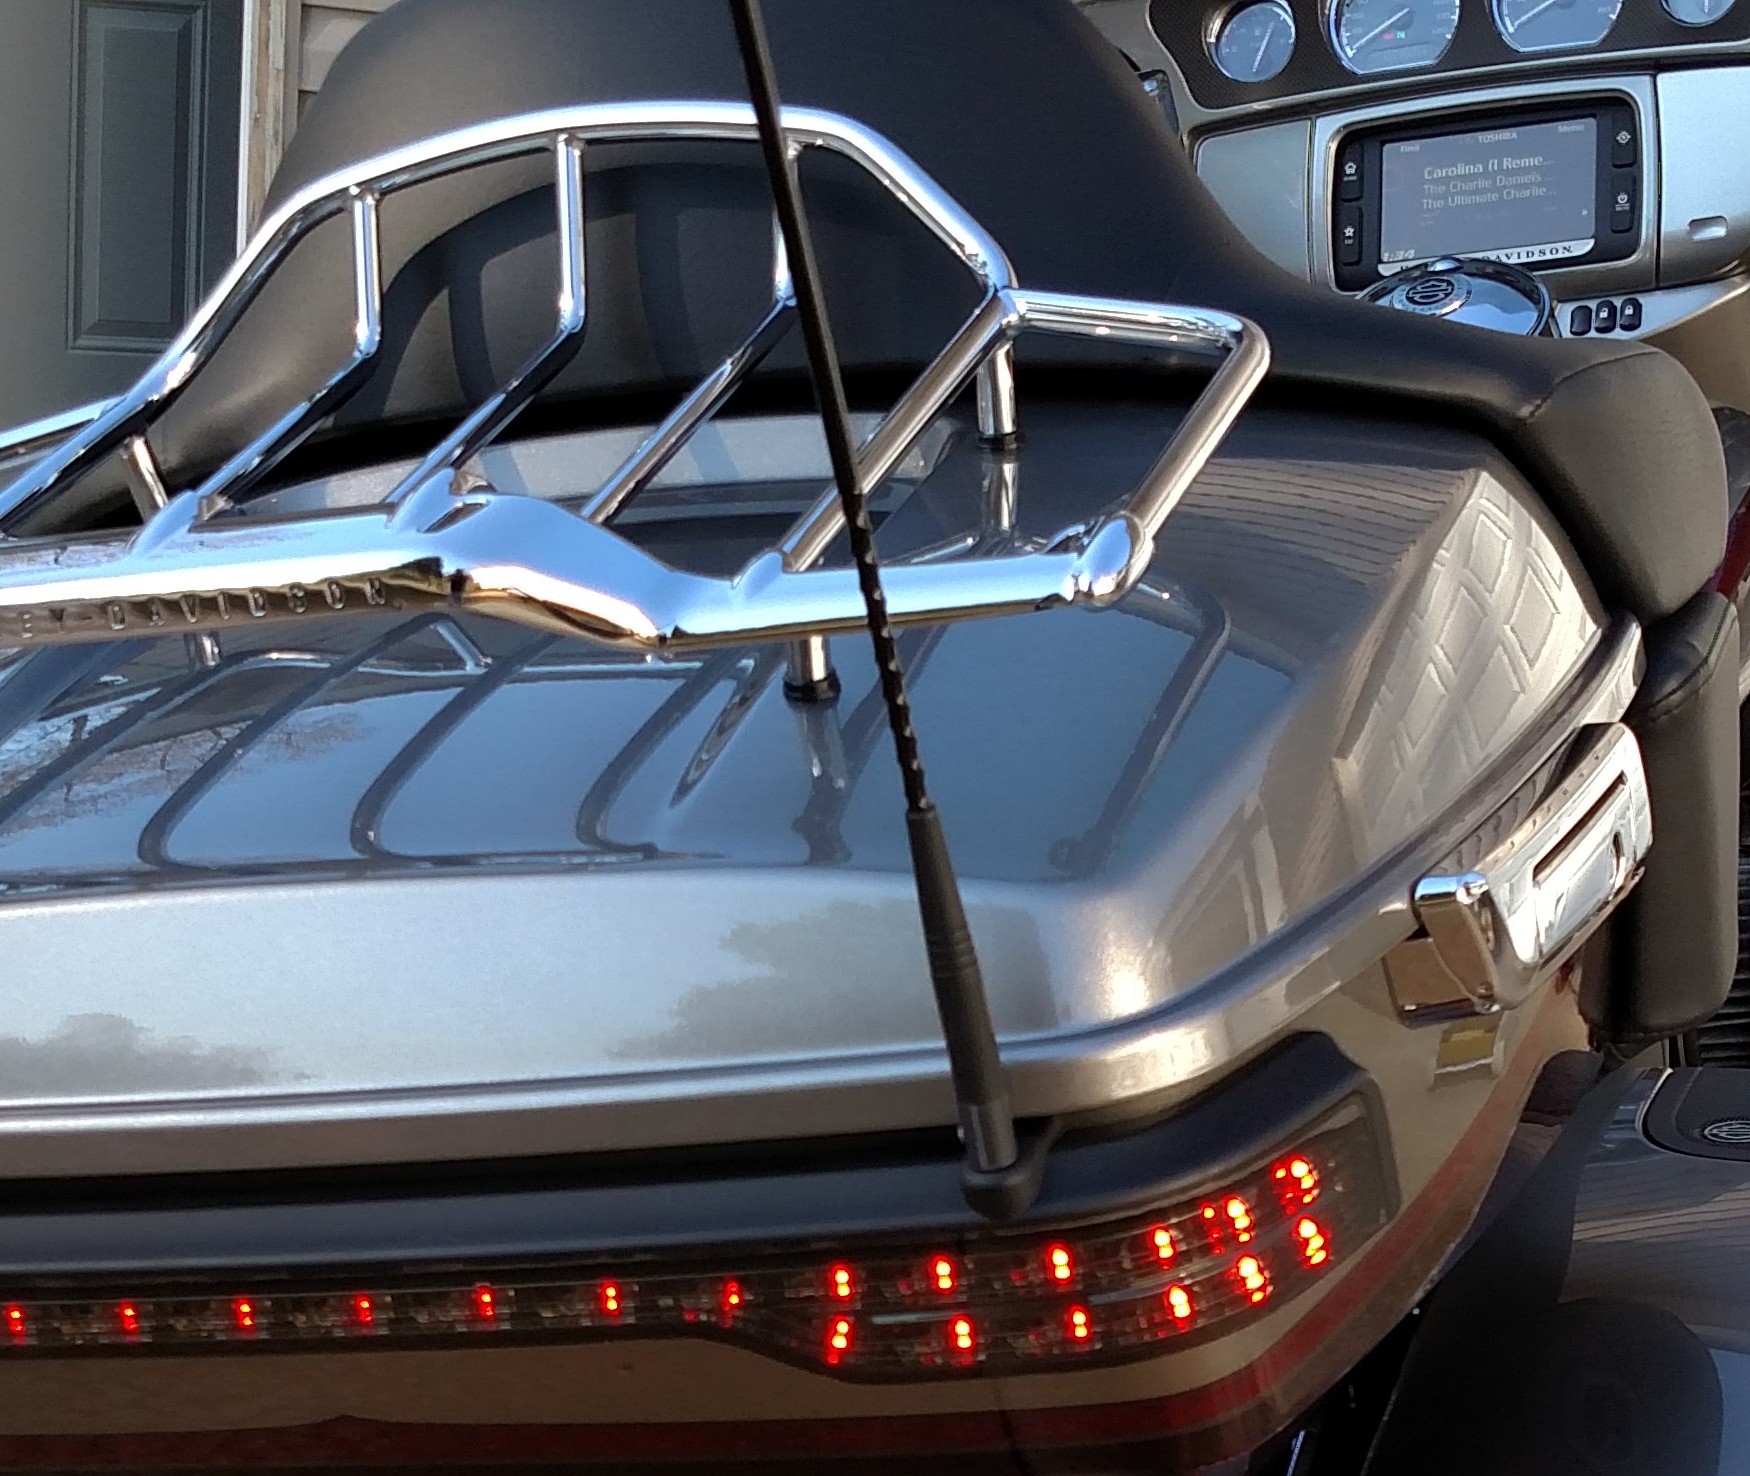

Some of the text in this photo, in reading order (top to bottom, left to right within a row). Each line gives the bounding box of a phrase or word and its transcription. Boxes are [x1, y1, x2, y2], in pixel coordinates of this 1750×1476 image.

[1478, 131, 1518, 144] TOSHIBA
[1424, 165, 1483, 180] Carolina
[1424, 172, 1541, 195] The Charlie Daniels
[1422, 187, 1547, 209] The Ultimate Charlie
